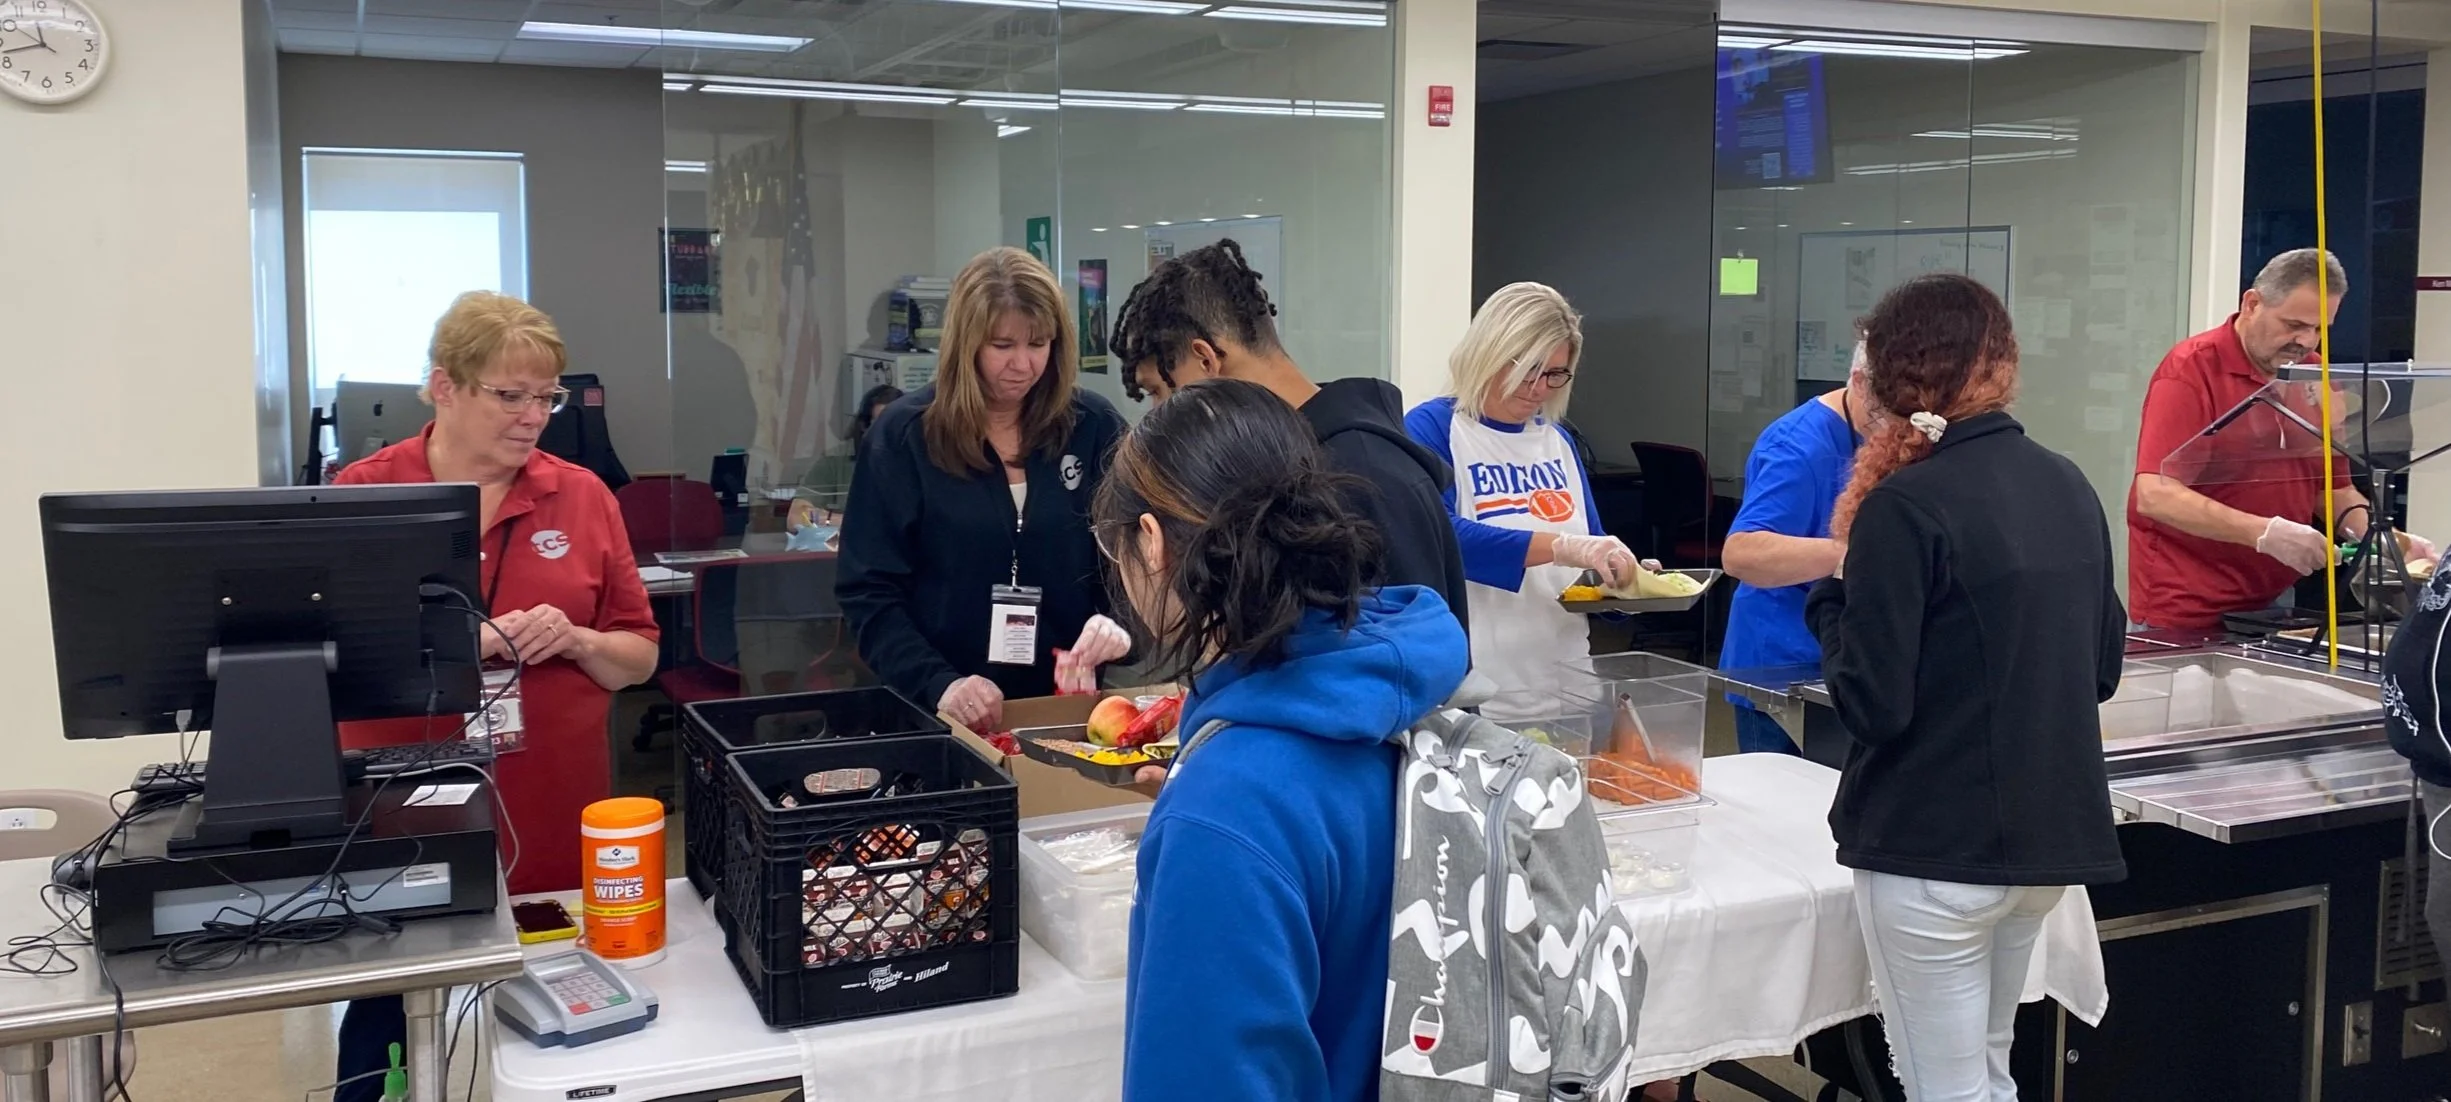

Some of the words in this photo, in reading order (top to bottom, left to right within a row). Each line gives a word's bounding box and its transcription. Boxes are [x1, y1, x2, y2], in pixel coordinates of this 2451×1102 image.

[75, 20, 85, 33] 2
[84, 39, 94, 52] 3
[2, 56, 12, 69] 8
[78, 58, 88, 70] 4
[21, 70, 31, 82] 7
[41, 76, 52, 88] 6
[65, 72, 74, 83] 5
[1434, 103, 1451, 112] FIRE
[1468, 459, 1567, 496] EDISON
[593, 876, 643, 885] DISINFECTING
[594, 884, 644, 898] WIPES
[1409, 834, 1459, 1056] Champion
[914, 961, 949, 983] Hiland
